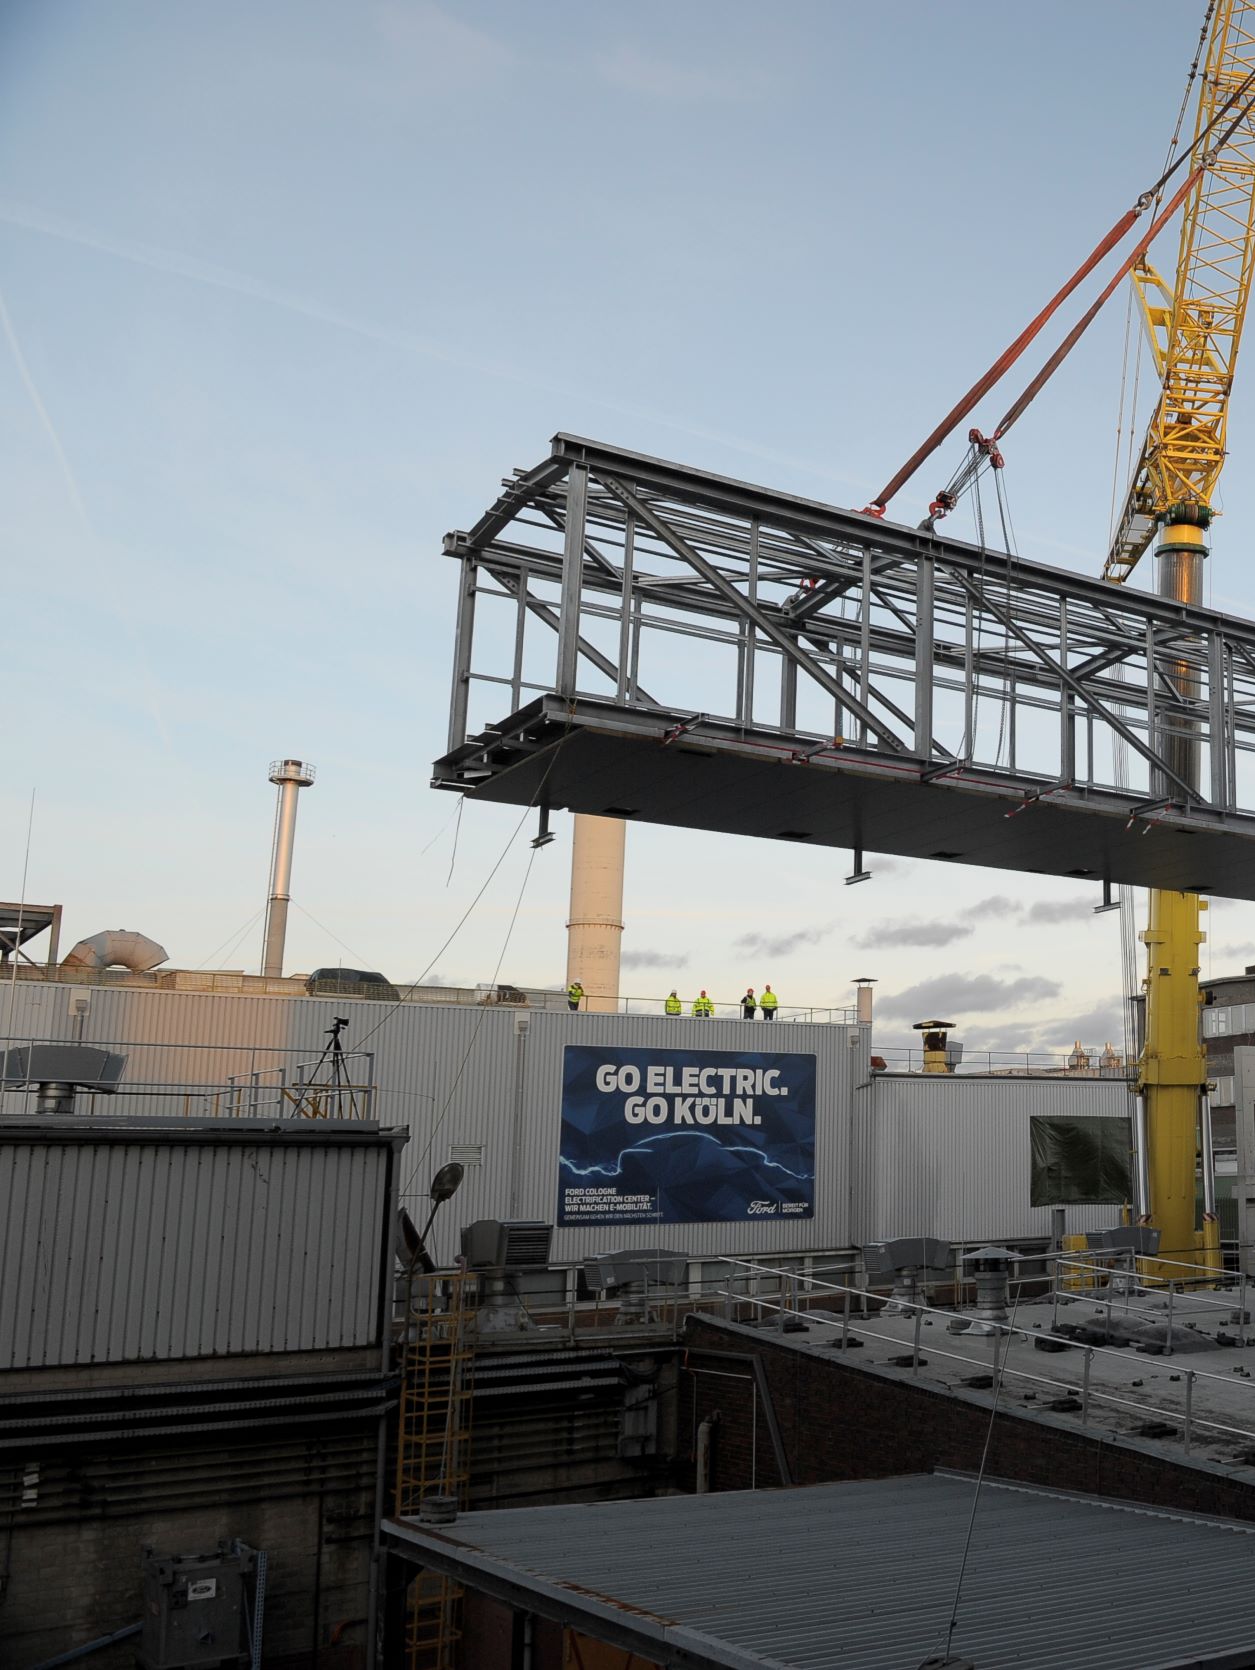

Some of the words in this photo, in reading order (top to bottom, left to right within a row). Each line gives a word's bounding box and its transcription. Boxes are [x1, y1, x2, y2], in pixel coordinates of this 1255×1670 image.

[595, 1064, 641, 1093] GO
[646, 1066, 788, 1096] ELECTRIC.
[624, 1096, 668, 1124] GO
[674, 1097, 762, 1125] KÖLN.
[565, 1188, 584, 1196] FORD
[585, 1187, 617, 1195] COLOGNE
[565, 1195, 623, 1204] ELECTRIFICATION
[623, 1195, 650, 1203] CENTER
[565, 1204, 579, 1212] WIR
[579, 1204, 609, 1212] MACHEN
[610, 1202, 653, 1211] E-MOBILITÄT.
[747, 1200, 777, 1214] Ford
